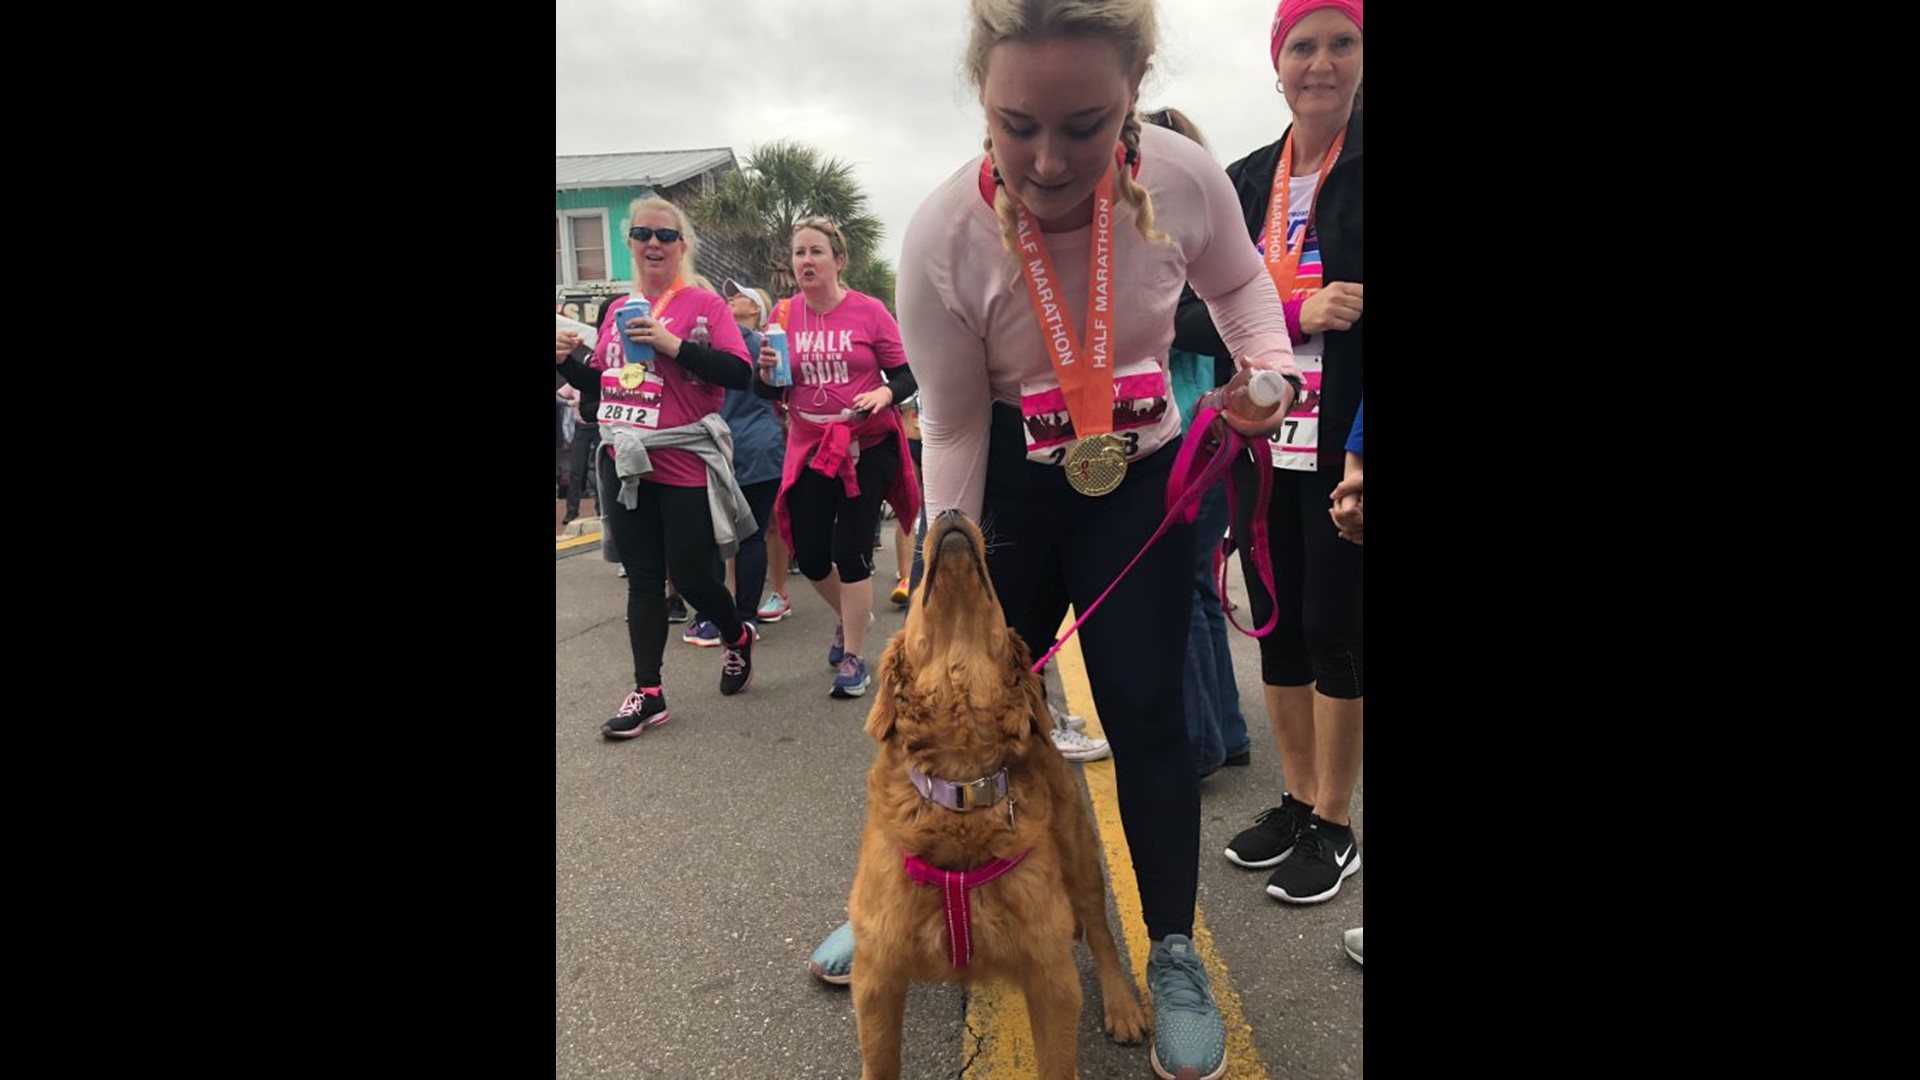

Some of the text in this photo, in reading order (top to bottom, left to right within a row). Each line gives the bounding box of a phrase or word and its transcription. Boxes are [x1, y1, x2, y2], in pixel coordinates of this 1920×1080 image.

[1269, 158, 1286, 263] HALF MARATHON
[1028, 258, 1075, 367] MARATHON
[1092, 198, 1109, 369] HALF MARATHON
[795, 330, 853, 353] WALK
[800, 361, 849, 385] RUN
[604, 404, 647, 424] 2812
